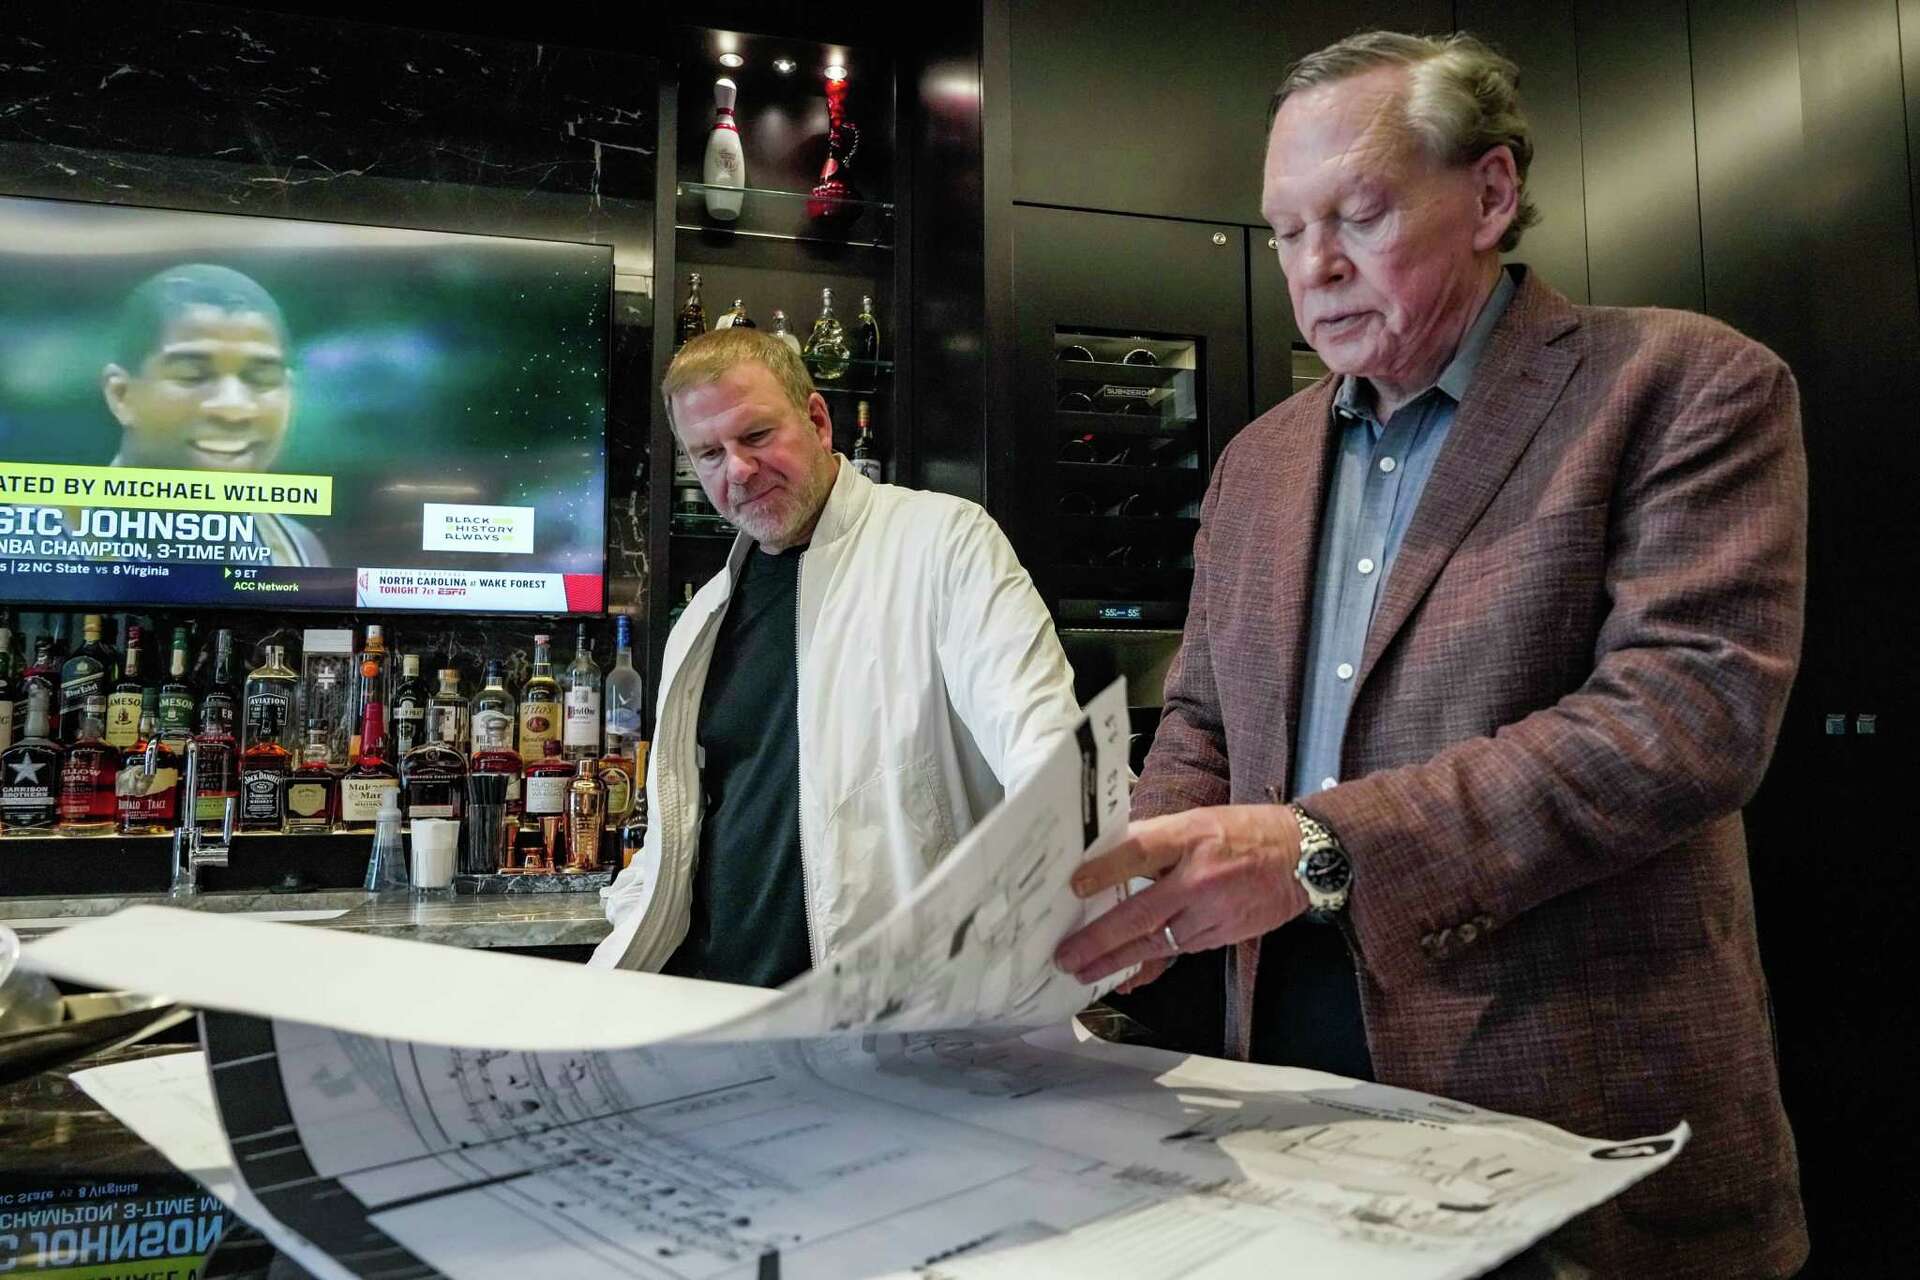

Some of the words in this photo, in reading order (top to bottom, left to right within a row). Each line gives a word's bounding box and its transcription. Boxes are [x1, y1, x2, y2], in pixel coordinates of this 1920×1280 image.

[64, 478, 96, 495] BY
[104, 479, 216, 500] MICHAEL
[224, 485, 319, 504] WILBON
[445, 516, 490, 524] BLACK
[72, 510, 255, 543] JOHNSON
[456, 525, 513, 533] HISTORY
[445, 532, 500, 541] ALWAYS
[40, 540, 152, 560] CHAMPION,
[157, 543, 225, 560] 3-TIME
[230, 546, 271, 561] MVP
[17, 563, 30, 572] 22
[33, 563, 52, 573] NC
[56, 563, 90, 574] State
[95, 566, 108, 574] vs
[113, 565, 120, 574] 8
[123, 565, 169, 577] Virginia
[235, 569, 242, 578] 9
[244, 569, 258, 578] ET
[234, 582, 256, 591] ACC
[258, 582, 299, 592] Network
[379, 576, 414, 585] NORTH
[417, 577, 467, 586] CAROLINA
[479, 579, 507, 587] WAKE
[510, 580, 546, 589] FOREST
[380, 586, 418, 594] TONIGHT
[438, 587, 467, 596] ESPN
